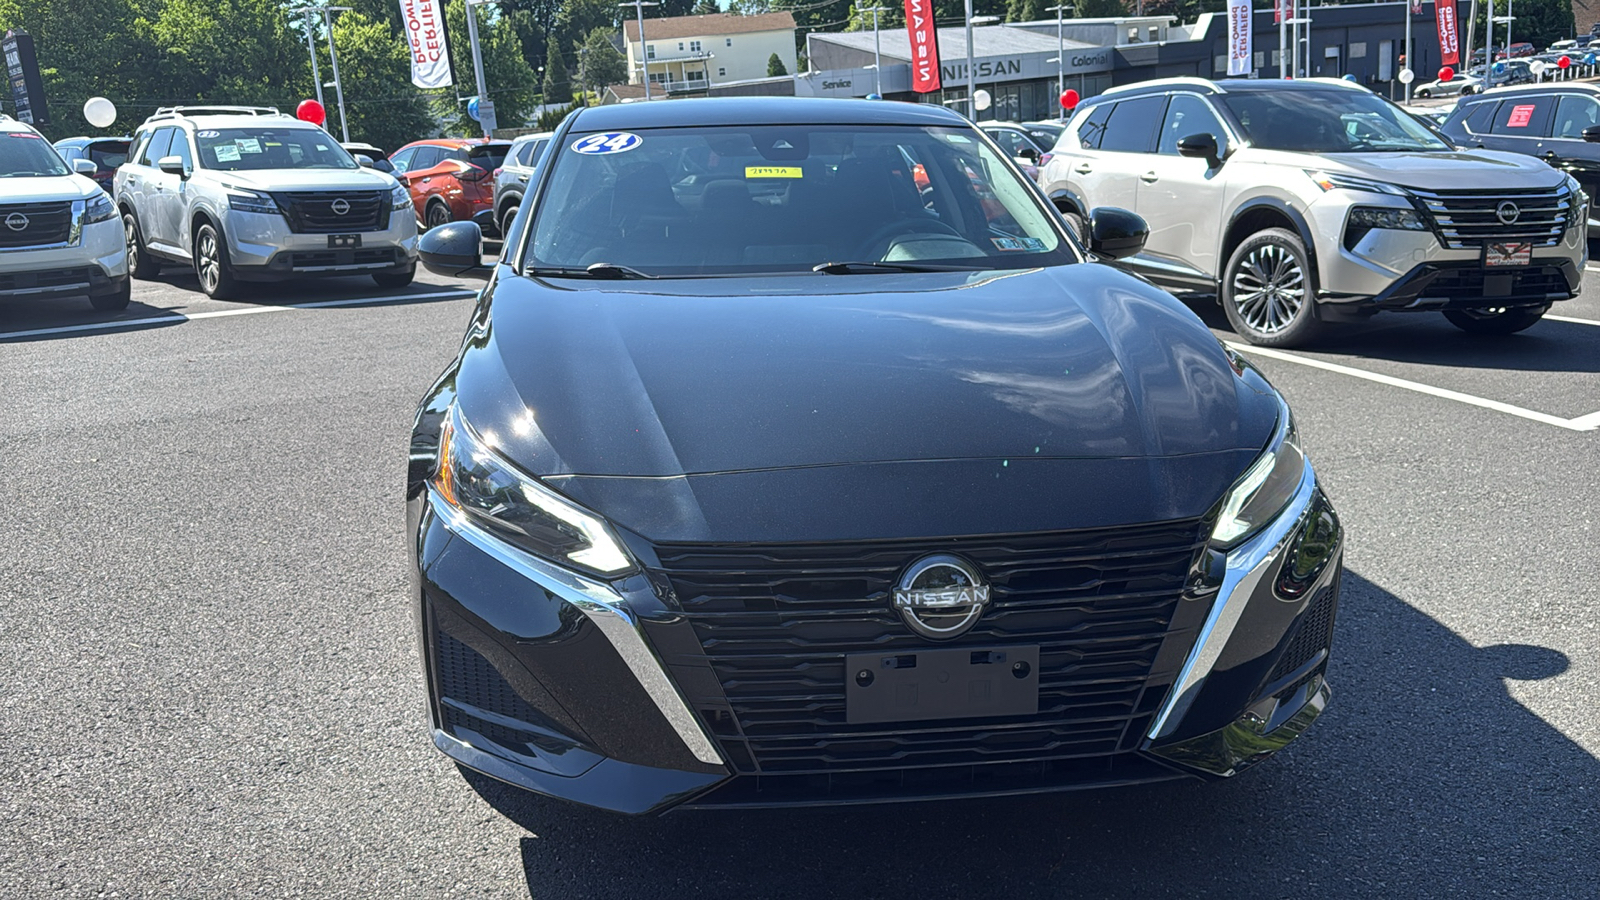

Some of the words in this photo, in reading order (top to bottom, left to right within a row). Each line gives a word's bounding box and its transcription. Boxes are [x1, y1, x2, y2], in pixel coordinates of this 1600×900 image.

[1071, 53, 1108, 67] Colonial
[943, 59, 1021, 81] NISSAN
[822, 78, 852, 90] Service
[579, 134, 634, 151] 24
[896, 588, 987, 605] NISSAN
